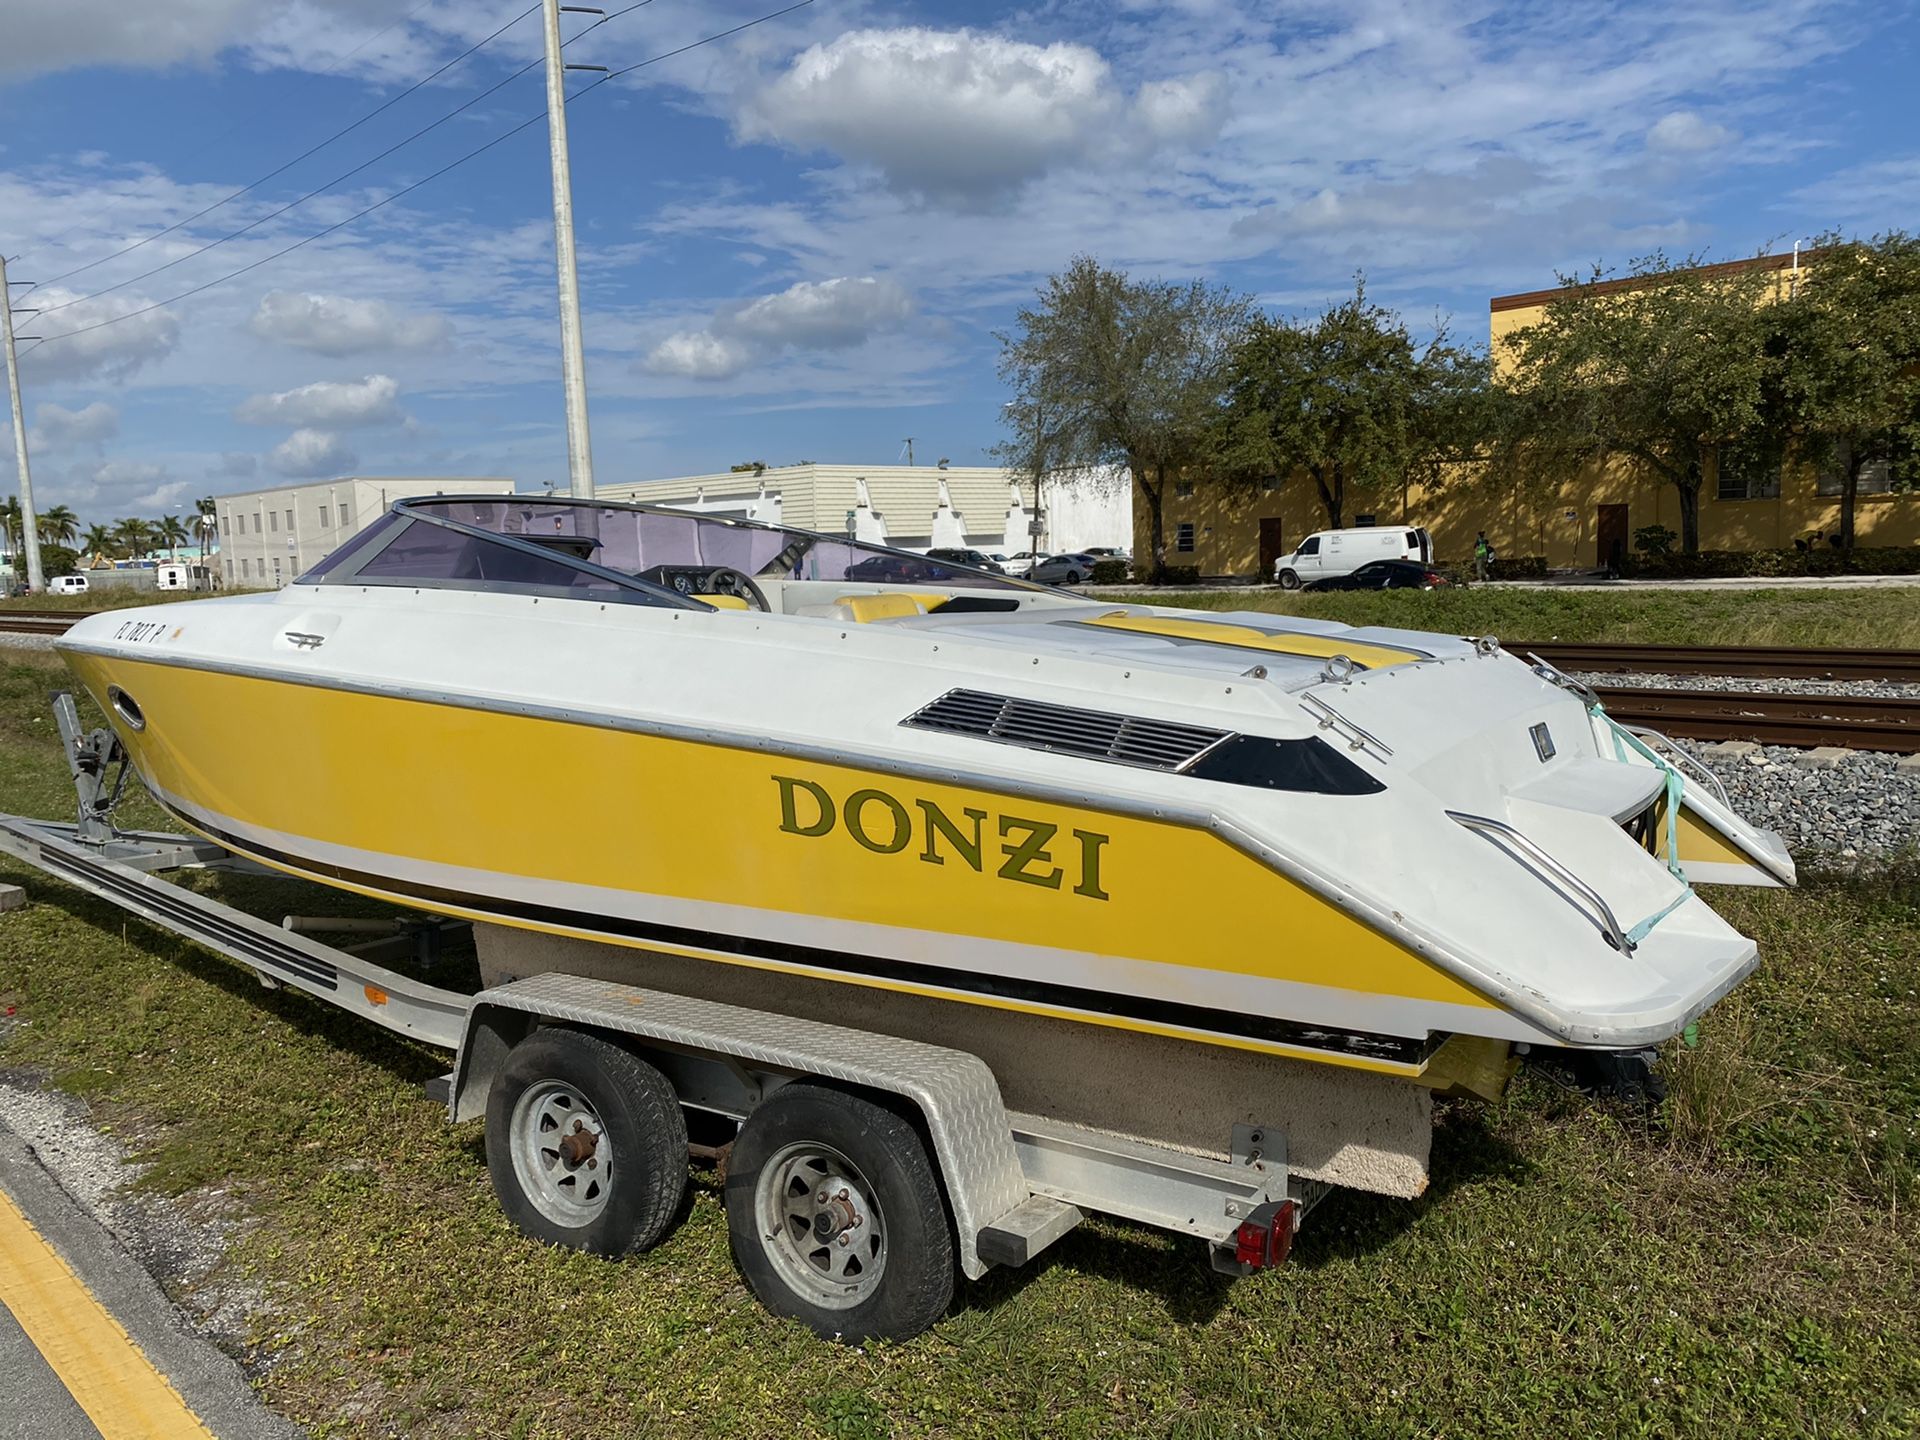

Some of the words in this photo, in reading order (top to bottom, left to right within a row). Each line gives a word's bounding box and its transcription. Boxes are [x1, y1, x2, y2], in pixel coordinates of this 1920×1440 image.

[114, 621, 132, 639] FL
[149, 624, 167, 642] P
[770, 774, 1110, 902] DONZI
